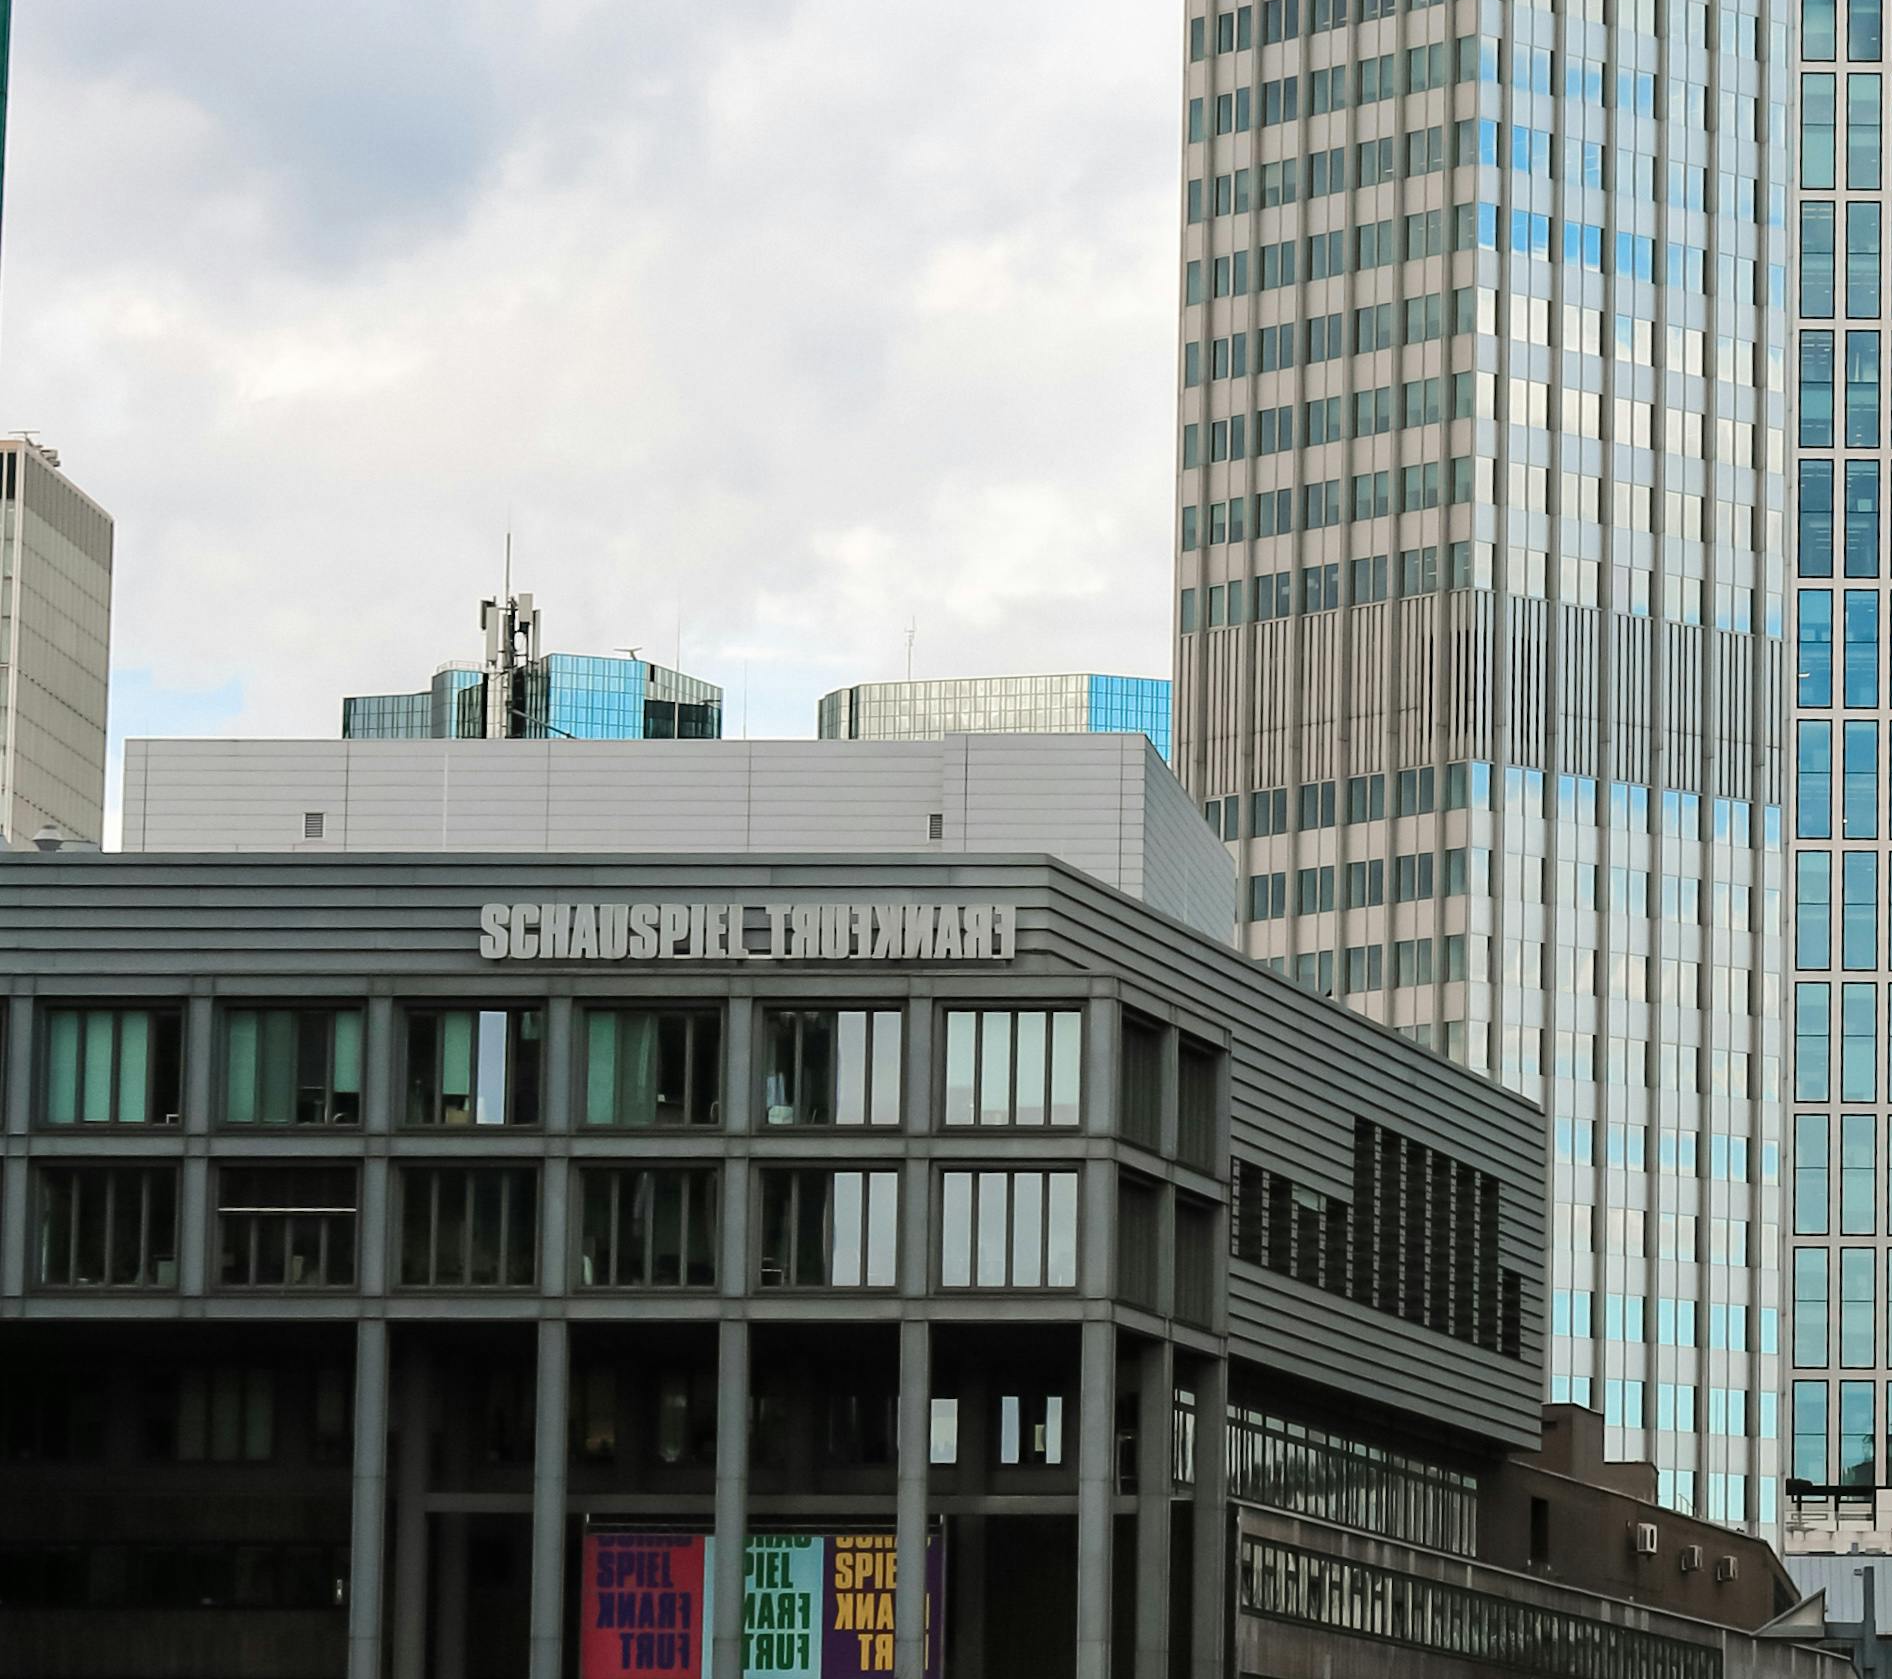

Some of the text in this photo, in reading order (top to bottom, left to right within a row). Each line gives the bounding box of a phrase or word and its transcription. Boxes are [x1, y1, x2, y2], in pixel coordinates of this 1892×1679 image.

[480, 904, 749, 959] SCHAUSPIEL
[597, 1552, 674, 1588] SPIEL
[743, 1552, 793, 1589] PIEL
[835, 1552, 897, 1589] SPIE
